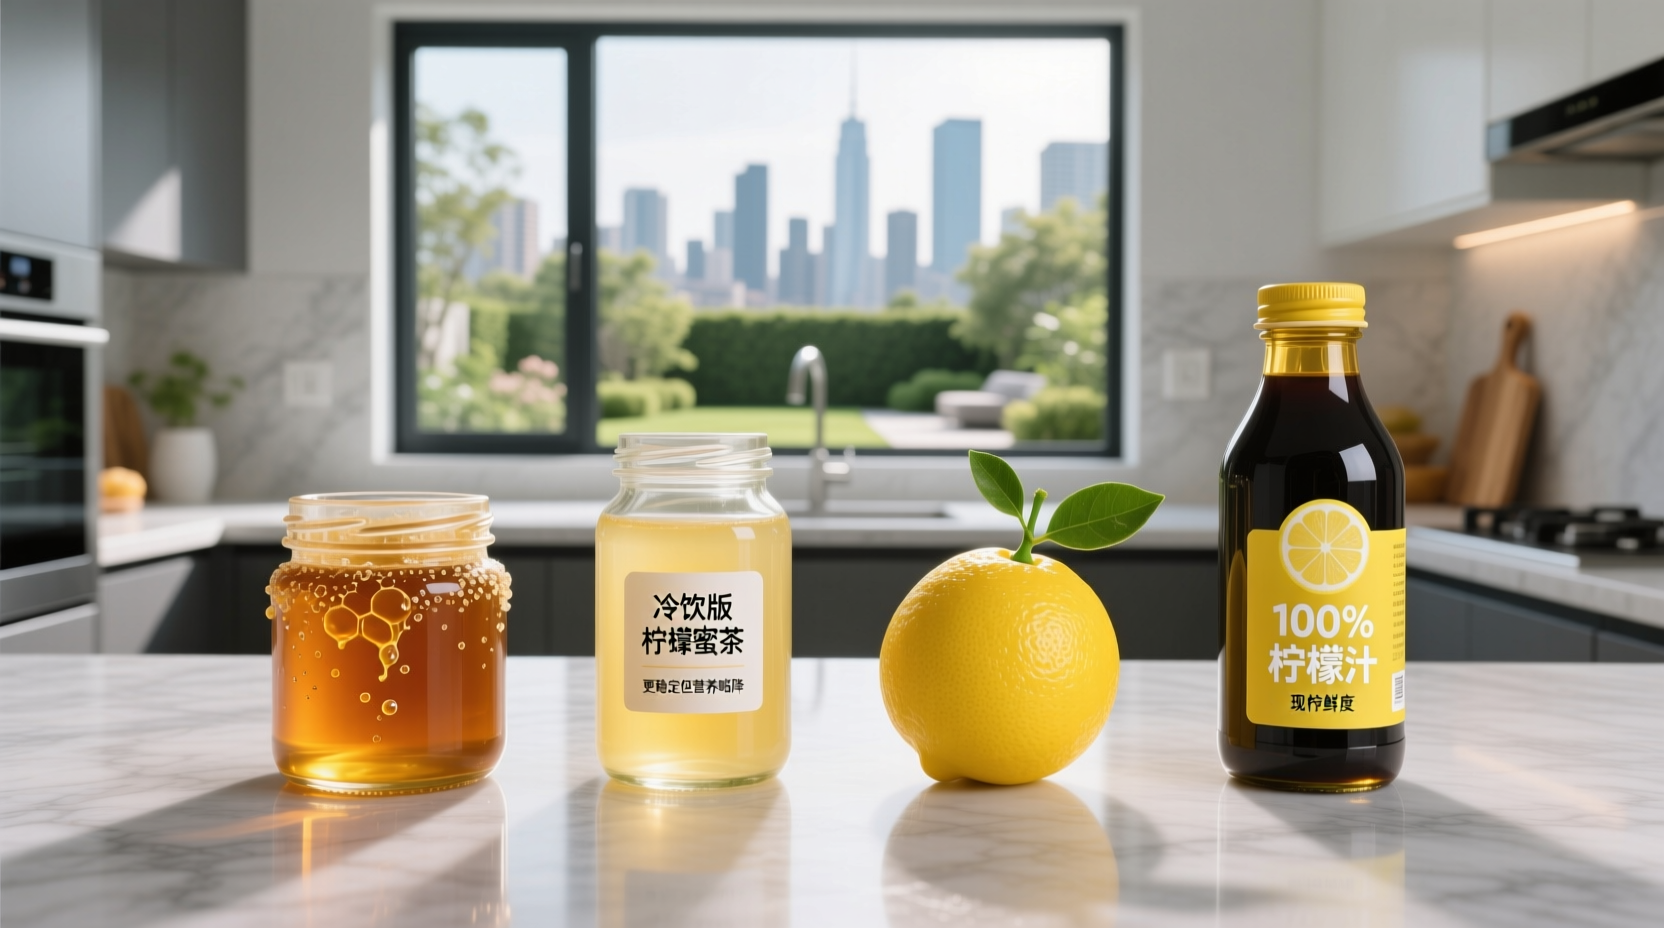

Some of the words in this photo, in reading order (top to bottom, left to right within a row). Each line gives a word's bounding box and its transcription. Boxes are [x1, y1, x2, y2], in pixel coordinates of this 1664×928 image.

[653, 592, 733, 621] 冷饮版
[1272, 603, 1374, 639] 100%
[1267, 642, 1378, 685] 柠檬汁
